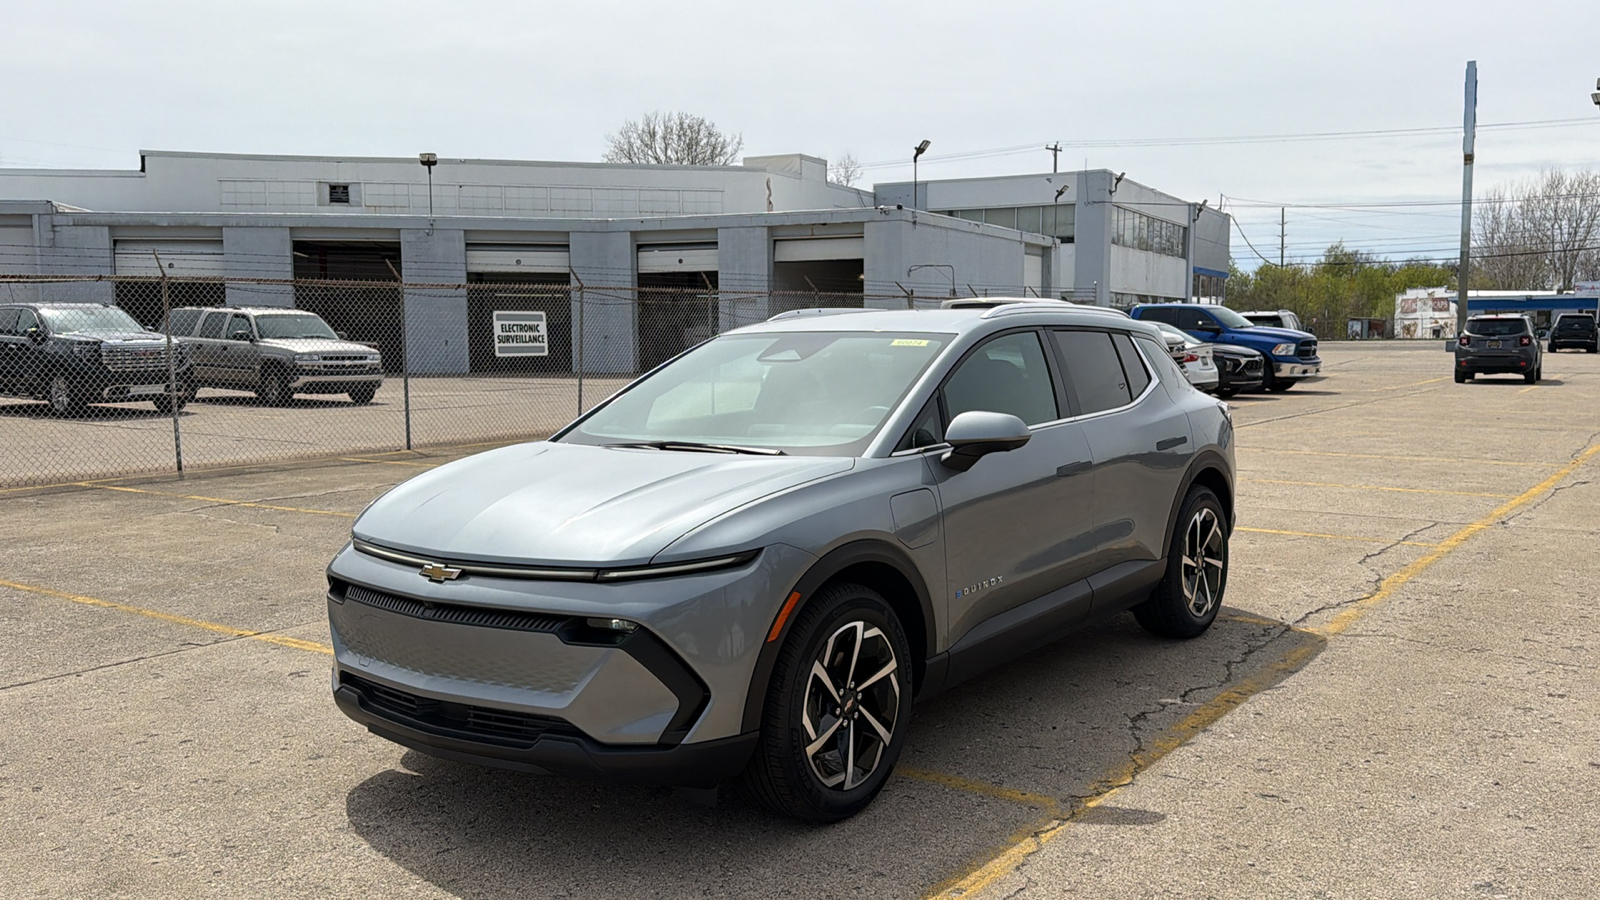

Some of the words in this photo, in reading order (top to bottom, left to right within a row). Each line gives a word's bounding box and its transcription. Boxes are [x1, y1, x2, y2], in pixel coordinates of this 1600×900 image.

[500, 323, 540, 333] ELECTRONIC
[497, 334, 545, 344] SURVEILLANCE
[956, 575, 1003, 598] EQUINOX
